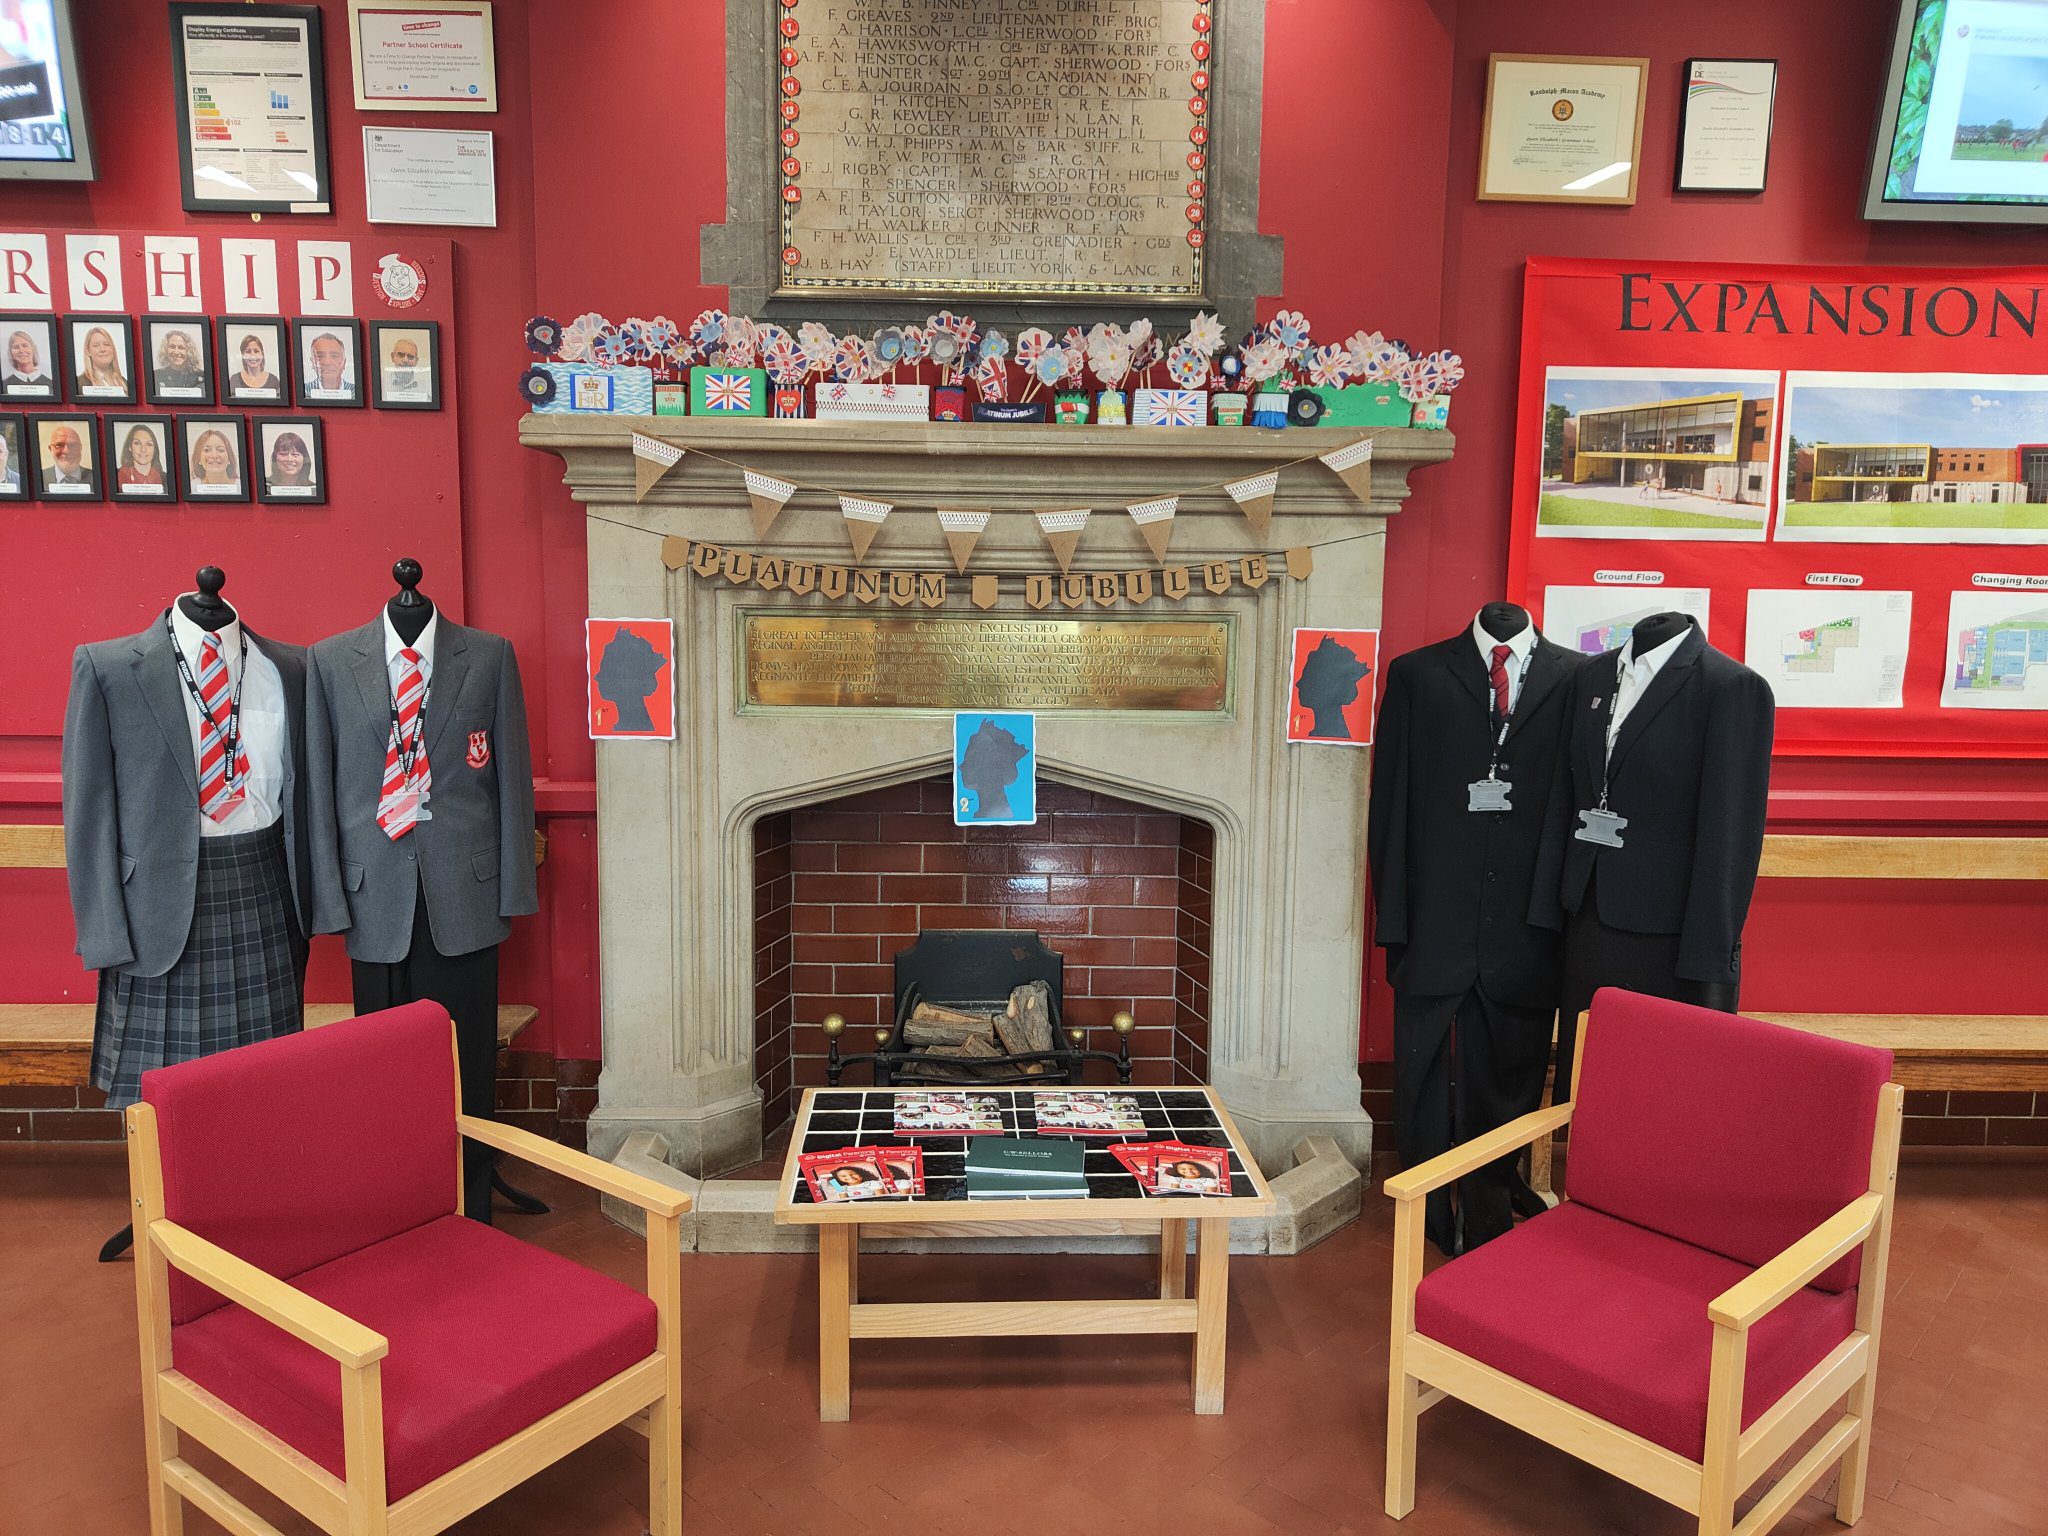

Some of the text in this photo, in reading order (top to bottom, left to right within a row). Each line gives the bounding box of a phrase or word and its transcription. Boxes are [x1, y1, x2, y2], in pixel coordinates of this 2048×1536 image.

[925, 0, 980, 10] FINNEY
[847, 10, 912, 22] GREAVES
[973, 13, 1068, 26] LIEUTENANT
[860, 24, 1098, 40] HARRISON SHERWOOD
[858, 39, 980, 52] HAWKSWORTH
[855, 53, 939, 66] HENSTOCK
[1054, 58, 1141, 70] SHERWOOD
[858, 67, 921, 79] HUNTER
[1026, 71, 1107, 83] CANADIAN
[879, 81, 961, 94] JOURDAIN
[1581, 89, 1606, 99] Academy
[899, 95, 1053, 110] KITCHEN SAPPER
[893, 109, 955, 122] KEWLEY
[894, 123, 960, 136] LOCKER
[980, 125, 1046, 138] PRIVATE
[905, 137, 954, 150] PHIPPS
[1038, 141, 1066, 152] BAR
[922, 152, 981, 164] POTTER
[843, 163, 891, 176] RIGBY
[1028, 168, 1109, 180] SEAFORTH
[887, 179, 1068, 193] SPENCER SHERWOOD
[888, 192, 1032, 206] SUTTON PRIVATE
[860, 205, 1095, 220] TAYLOR SHERWOOD
[883, 220, 1039, 234] WALKER GUNNER
[855, 232, 1122, 249] WALLIS GRENADIER
[910, 248, 976, 260] WARDLE
[840, 260, 872, 271] HAY
[894, 260, 952, 273] (STAFF)
[1616, 273, 2045, 339] EXPANSION
[700, 546, 1263, 605] PLATINUM JUBILEE
[1596, 573, 1662, 581] Ground Floor
[1832, 575, 1860, 584] Floor
[1973, 575, 2022, 586] Changing
[915, 622, 1058, 634] GLORIA EXCELSIS DEO
[979, 634, 1012, 643] LIBERA
[1014, 634, 1057, 644] SCHOLA
[1061, 634, 1150, 645] GRAMMATICALIS
[997, 645, 1049, 654] COMITATV
[1053, 645, 1098, 654] DERBIAE
[1177, 646, 1222, 656] SCHOLA
[810, 653, 1051, 664] PER EST ANNO
[180, 661, 192, 682] STUDENT
[1015, 666, 1052, 674] EST ET
[967, 675, 1071, 684] SCHOLA REGNANTE
[193, 690, 208, 713] STUDENT
[421, 688, 430, 709] STUDENT
[1006, 696, 1070, 705] FAC REGEM
[230, 714, 238, 739] STUDENT
[392, 721, 402, 745] STUDENT
[413, 718, 423, 742] STUDENT
